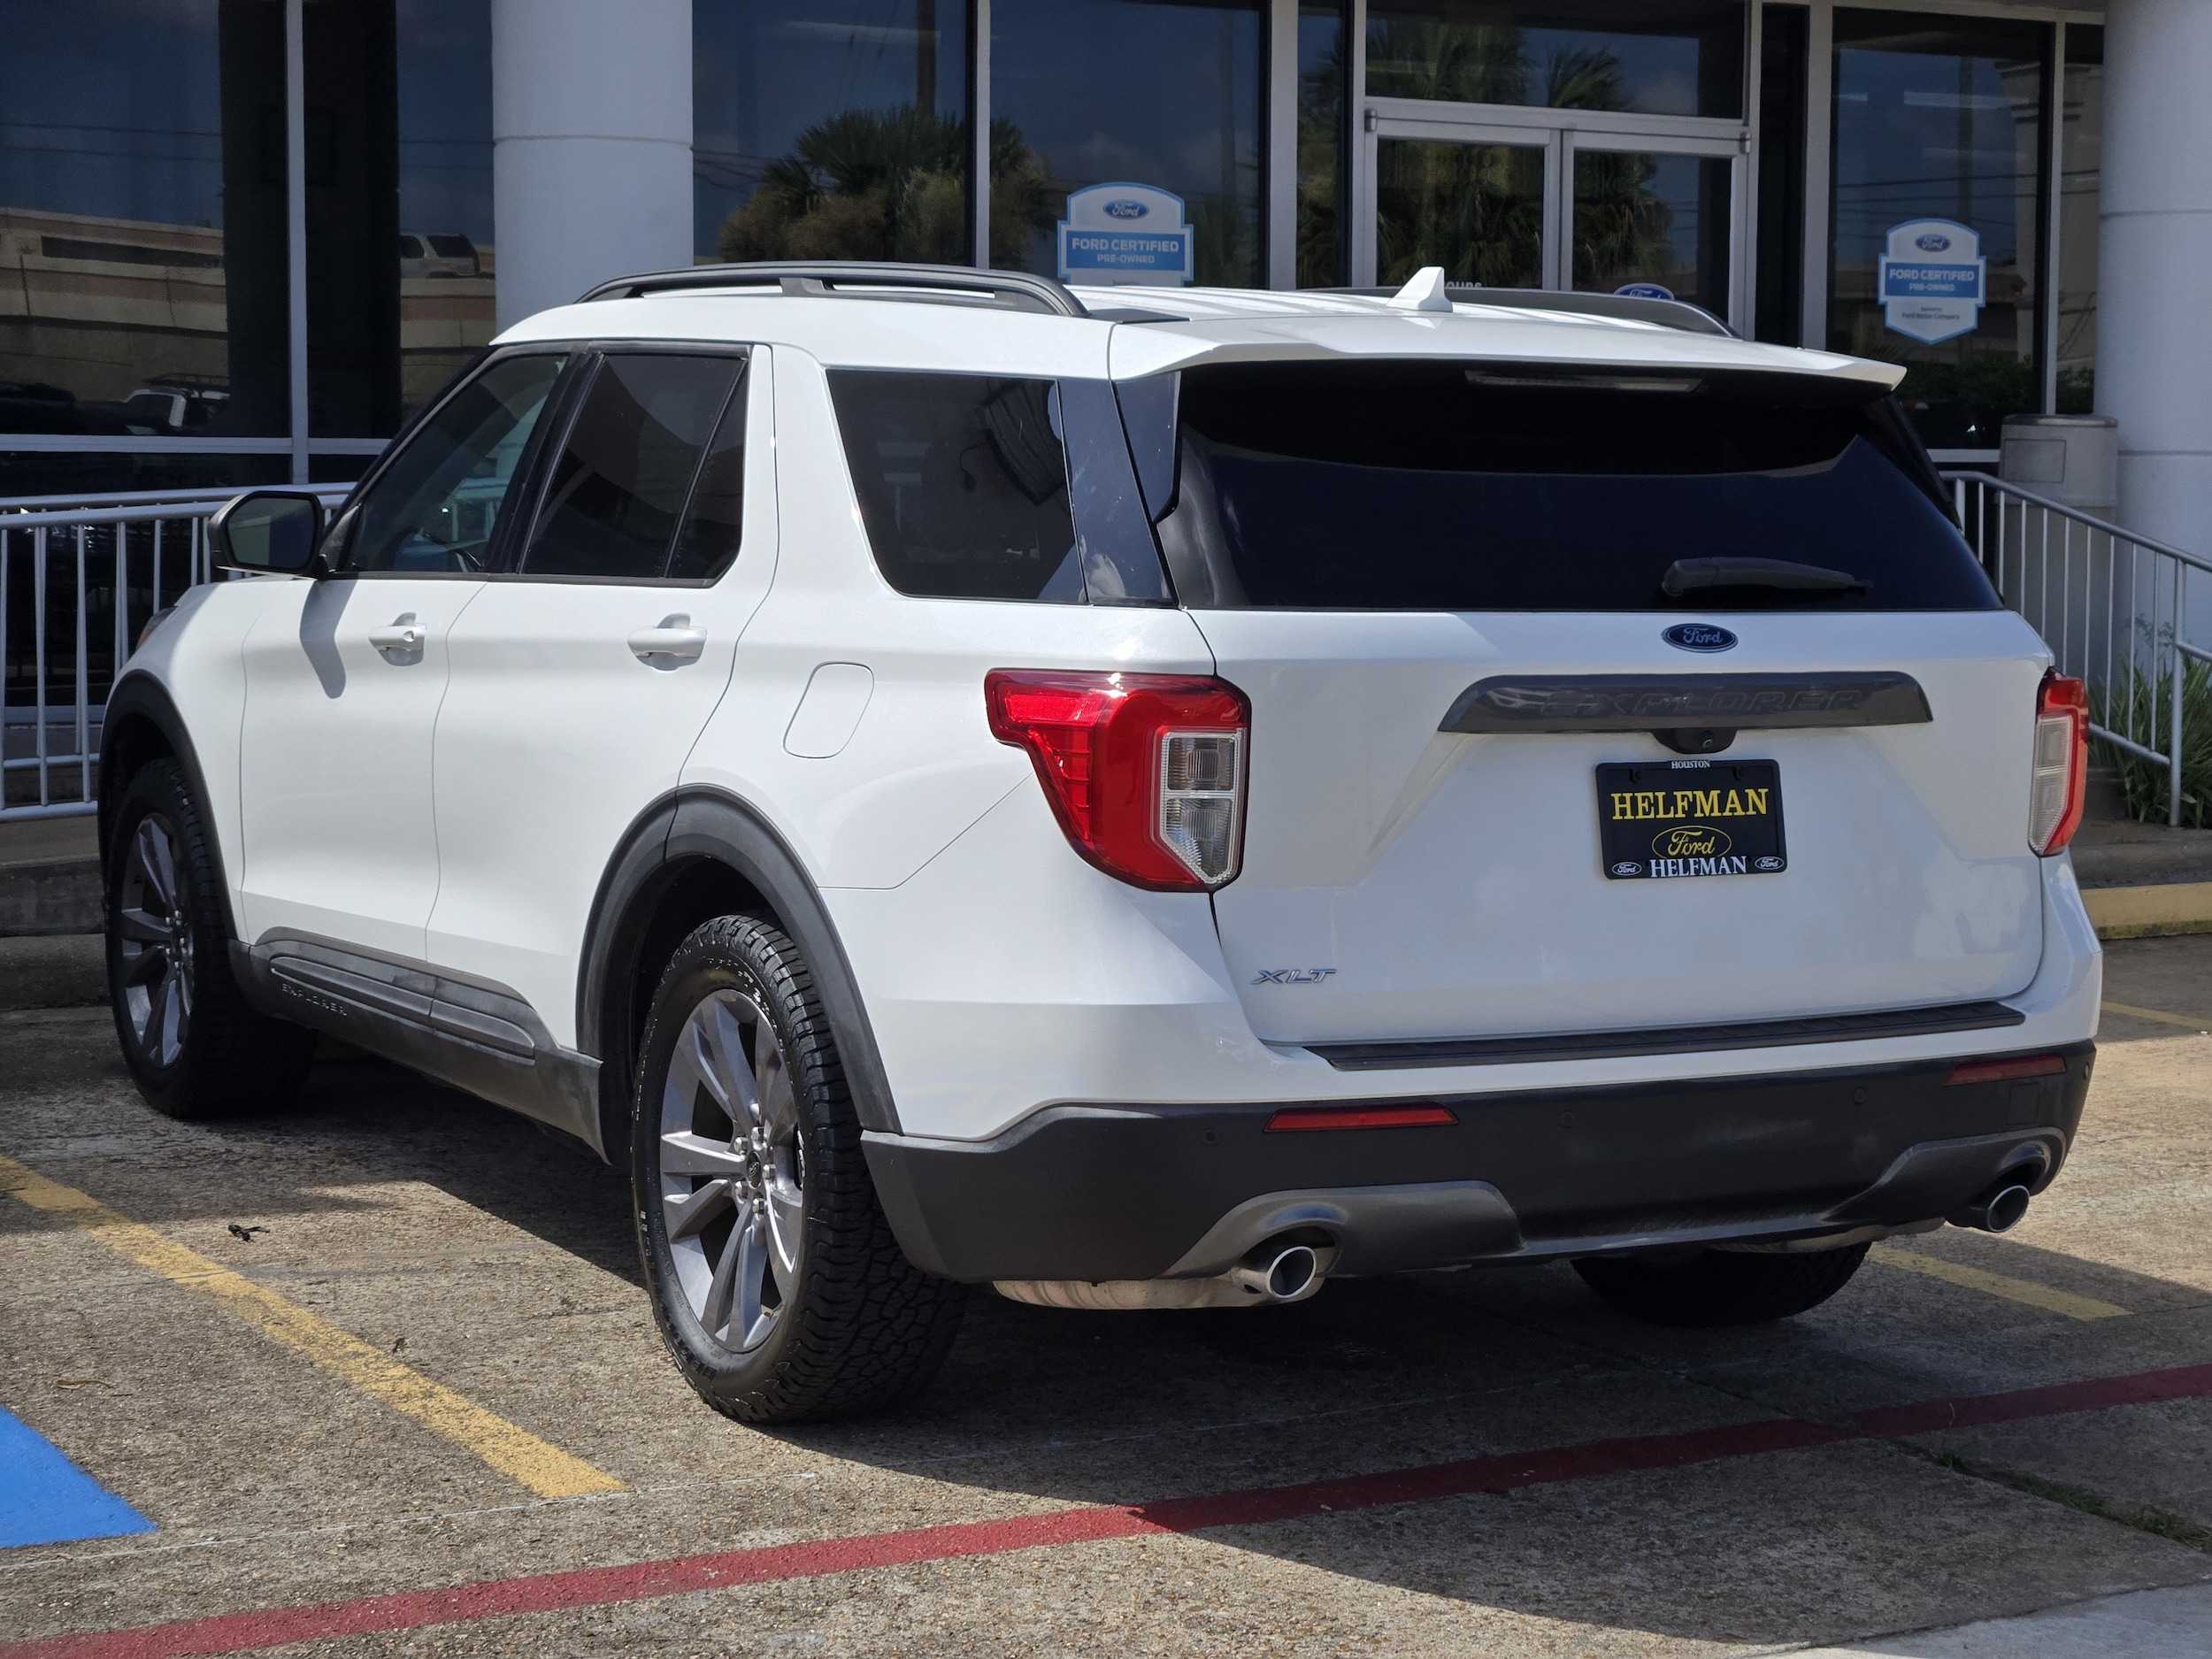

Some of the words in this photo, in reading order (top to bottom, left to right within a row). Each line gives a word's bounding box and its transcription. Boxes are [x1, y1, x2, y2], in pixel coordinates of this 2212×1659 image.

[1112, 203, 1140, 217] Ford
[1071, 238, 1109, 250] FORD
[1111, 240, 1179, 252] CERTIFIED
[1922, 236, 1943, 249] Ford
[1097, 254, 1155, 264] PRE-OWNED
[1889, 269, 1919, 280] FORD
[1920, 270, 1975, 281] CERTIFIED
[1909, 283, 1955, 292] PRE-OWNED
[1682, 626, 1724, 646] Ford
[1539, 689, 1863, 717] EXPLORER
[1671, 760, 1711, 770] HOUSTON
[1610, 787, 1769, 820] HELFMAN
[1667, 830, 1717, 856] Ford
[1617, 864, 1637, 875] Ford
[1649, 856, 1747, 878] HELFMAN
[1760, 857, 1780, 869] Ford
[1249, 968, 1337, 985] XLT
